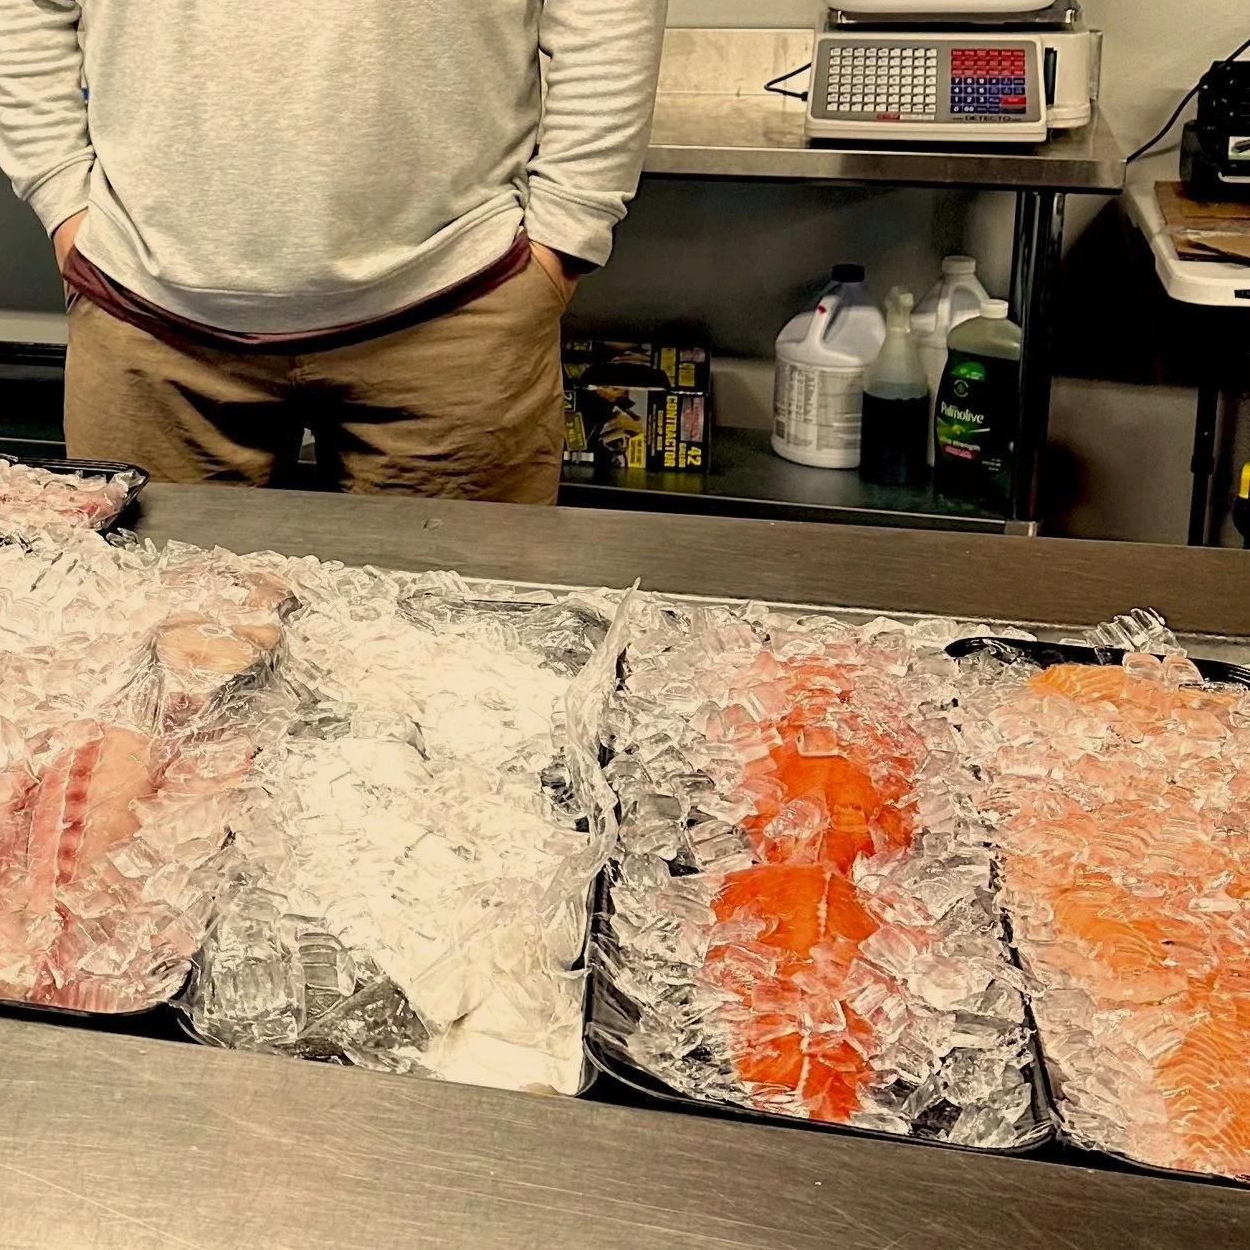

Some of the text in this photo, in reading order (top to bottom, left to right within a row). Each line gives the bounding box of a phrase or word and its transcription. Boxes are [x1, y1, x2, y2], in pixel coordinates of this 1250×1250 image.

[940, 401, 984, 424] Palmolive
[664, 396, 678, 467] CONTRACTOR
[687, 446, 702, 466] 42
